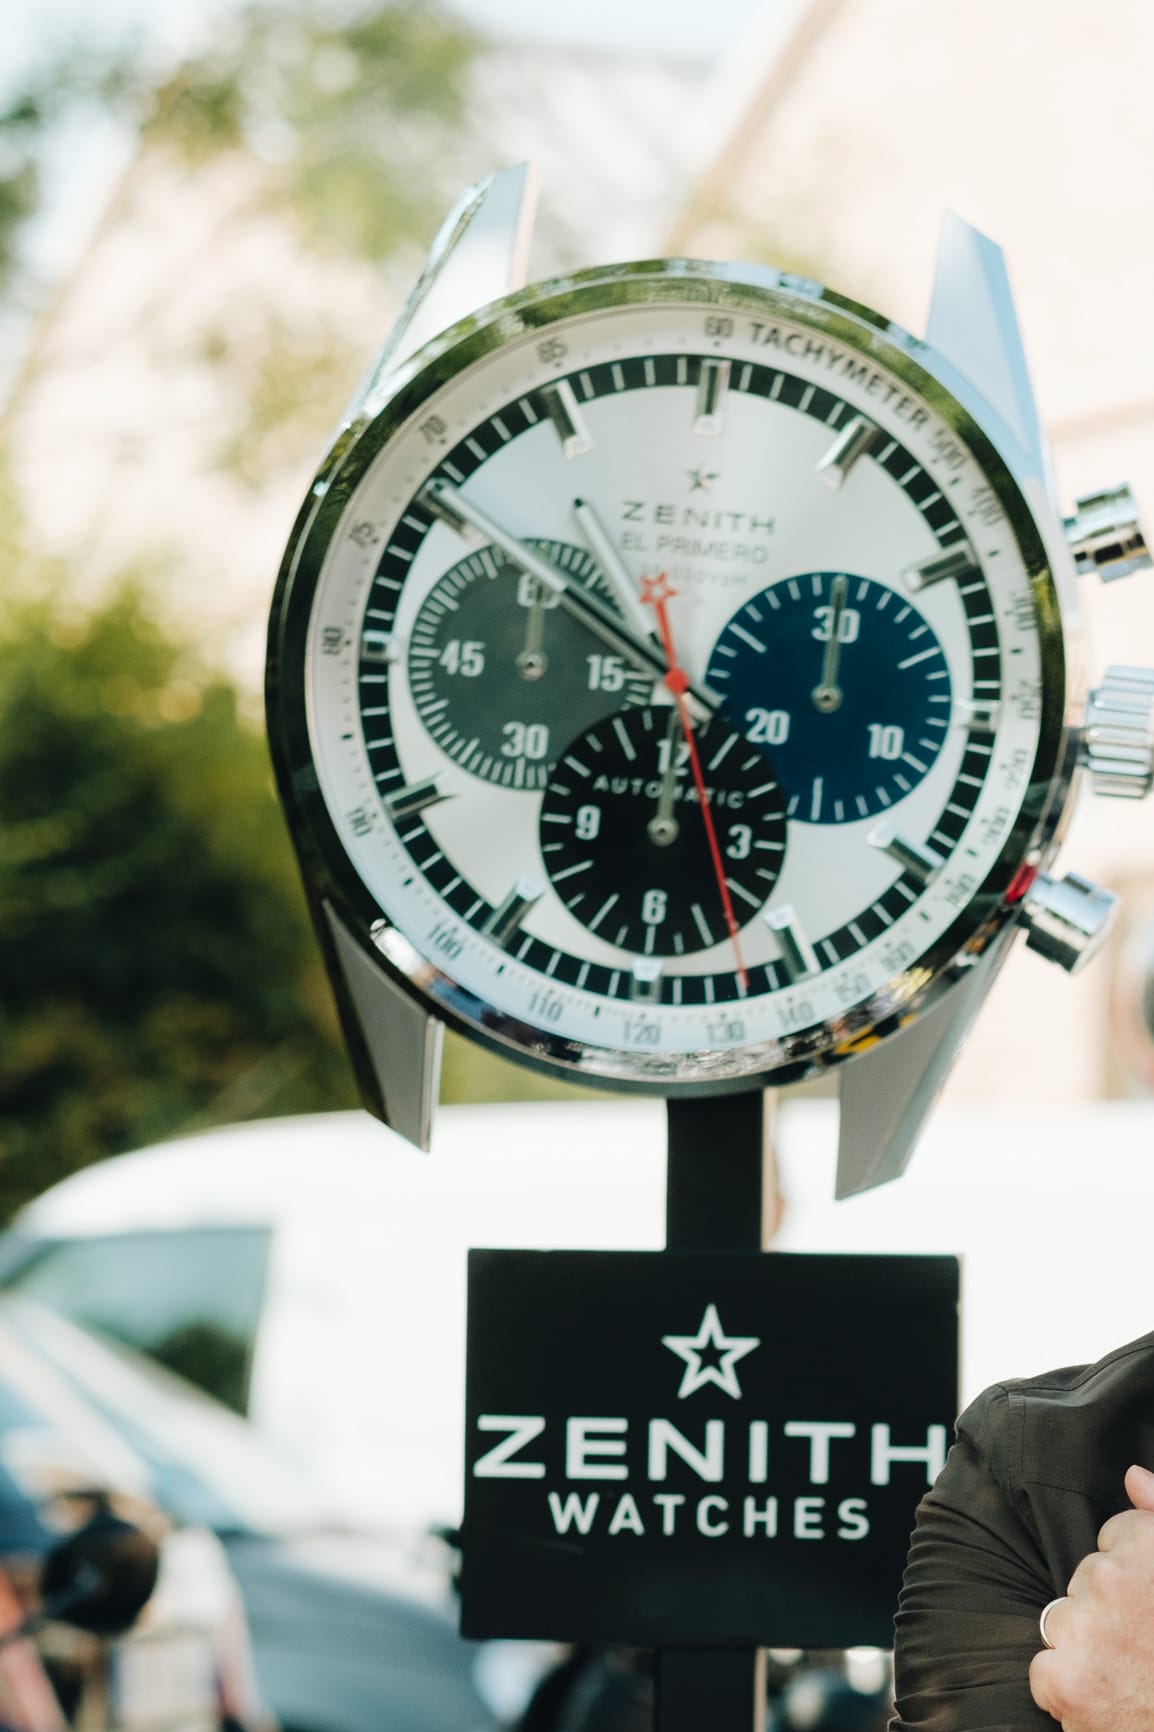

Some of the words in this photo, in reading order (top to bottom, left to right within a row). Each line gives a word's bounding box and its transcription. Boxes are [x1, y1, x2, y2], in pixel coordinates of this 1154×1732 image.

[751, 322, 929, 431] TACHYMETER
[622, 500, 775, 536] ZENITH
[811, 605, 861, 644] 30
[439, 639, 486, 677] 45
[586, 654, 625, 692] 15
[501, 721, 549, 760] 30
[745, 708, 790, 745] 20
[867, 723, 904, 761] 10
[657, 739, 693, 777] 12
[575, 805, 601, 840] 9
[726, 824, 752, 860] 3
[641, 889, 668, 925] 6
[622, 1020, 660, 1045] 120
[473, 1414, 948, 1487] ZENITH
[547, 1490, 871, 1541] WATCHES
